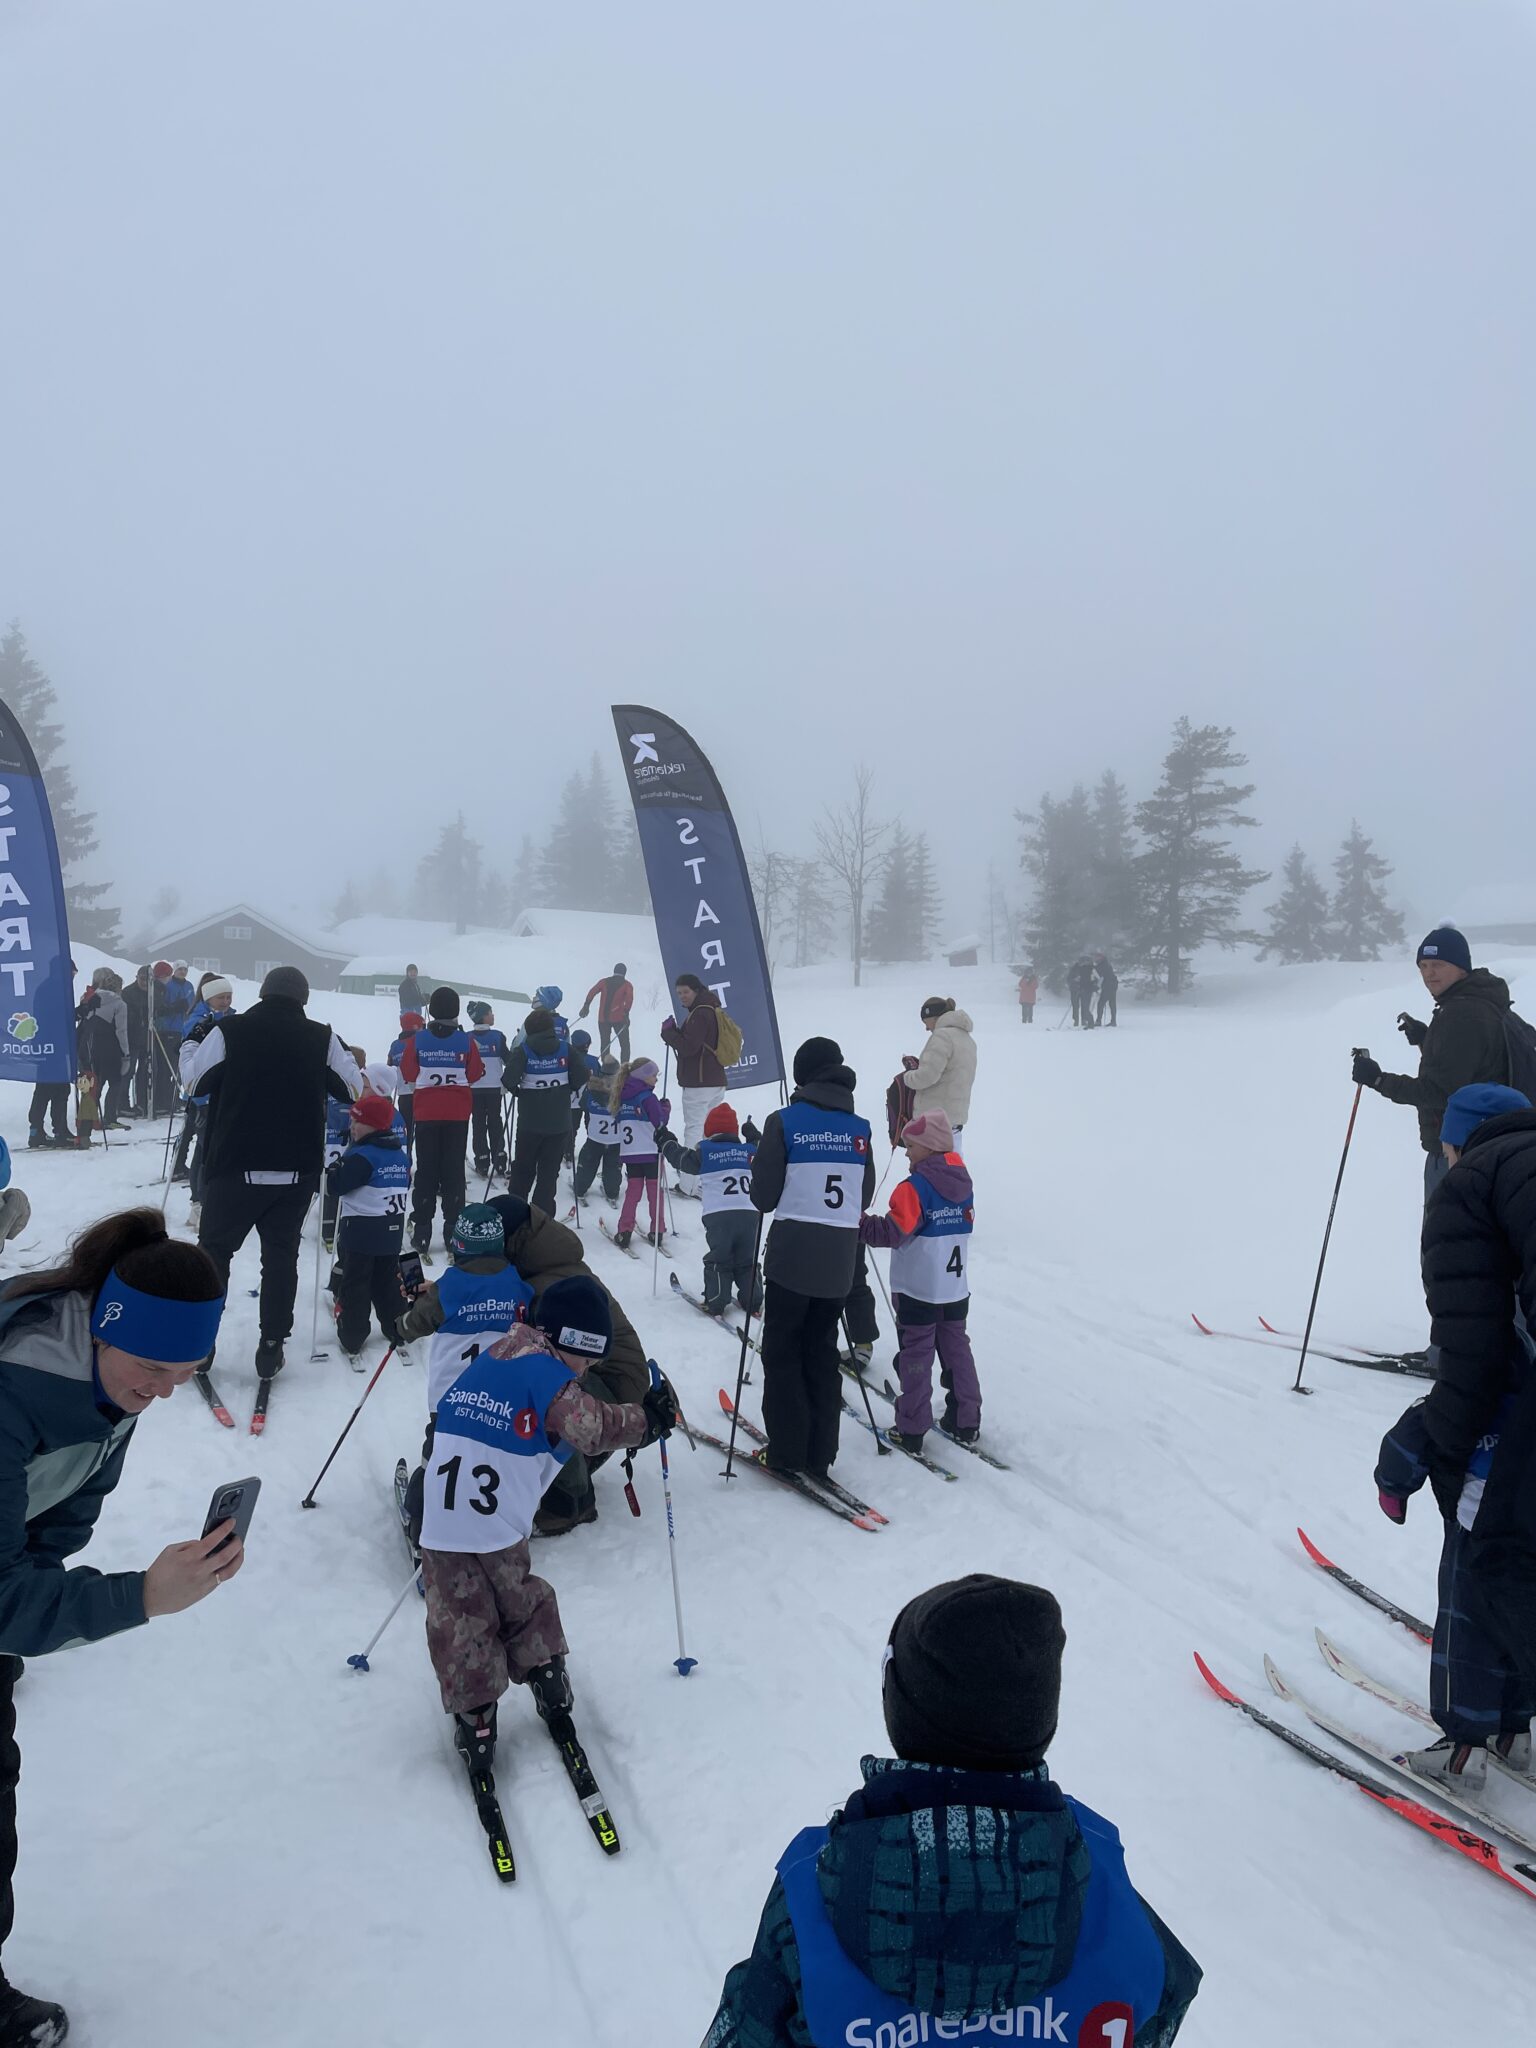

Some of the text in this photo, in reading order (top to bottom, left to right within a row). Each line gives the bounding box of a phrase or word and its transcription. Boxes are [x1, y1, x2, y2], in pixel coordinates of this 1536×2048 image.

[418, 1050, 456, 1058] SpareBank
[430, 1074, 462, 1086] 25
[598, 1120, 618, 1135] 21
[793, 1131, 865, 1150] SpareBank 1
[810, 1144, 853, 1152] ØSTLANDET
[708, 1148, 749, 1160] SpareBank
[722, 1175, 750, 1195] 20
[824, 1174, 844, 1209] 5
[946, 1245, 963, 1277] 4
[446, 1387, 532, 1433] SpareBank 1
[455, 1406, 511, 1432] ØSTLANDET
[437, 1455, 500, 1516] 13
